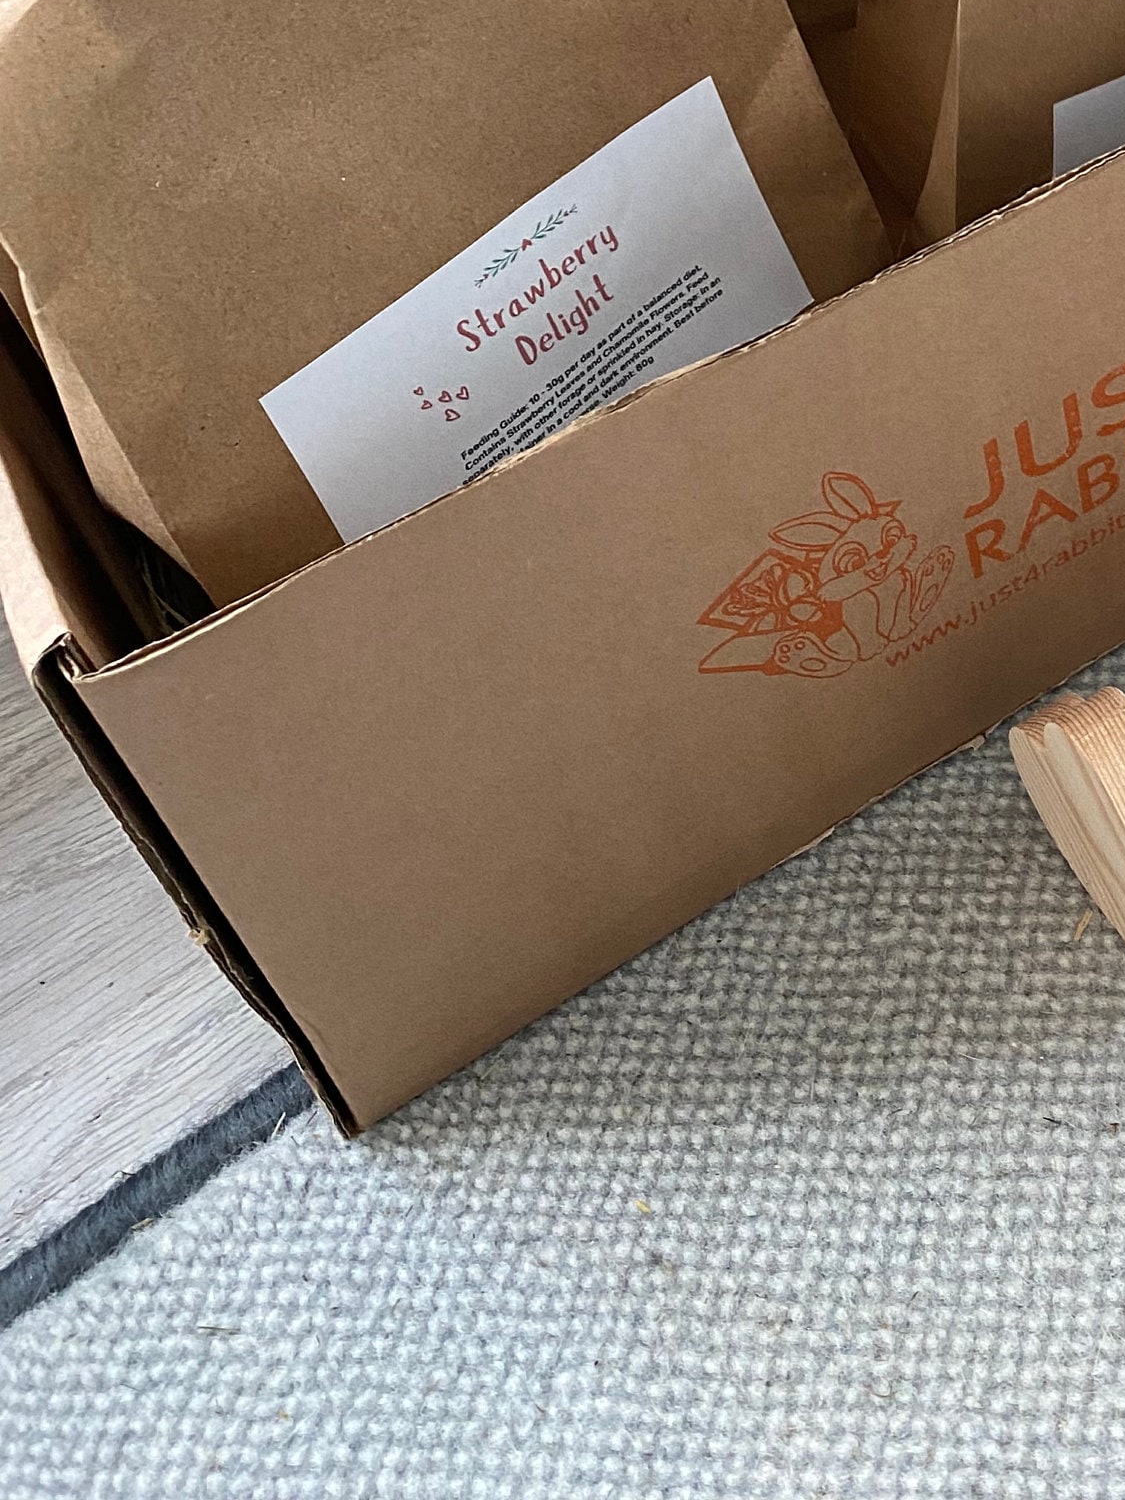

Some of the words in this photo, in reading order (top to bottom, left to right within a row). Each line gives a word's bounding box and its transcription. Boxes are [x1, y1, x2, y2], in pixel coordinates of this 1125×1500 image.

[456, 222, 619, 352] Strawberry
[512, 427, 534, 446] with
[533, 402, 557, 430] other
[556, 382, 586, 409] forage
[586, 373, 596, 385] or
[596, 339, 636, 376] sprinkled
[634, 334, 646, 344] in
[709, 276, 721, 288] an
[515, 274, 614, 365] Delight
[544, 423, 556, 434] in
[555, 417, 563, 426] a
[562, 398, 583, 419] cool
[582, 383, 600, 403] and
[598, 368, 620, 388] dark
[672, 308, 695, 329] Best
[692, 288, 723, 313] before
[459, 427, 500, 461] Feeding
[527, 392, 540, 405] 10
[545, 373, 565, 392] 30g
[563, 360, 579, 379] per
[579, 346, 596, 363] day
[595, 337, 608, 350] as
[606, 321, 626, 342] part
[625, 312, 636, 325] of
[636, 309, 643, 317] a
[641, 276, 683, 312] balanced
[464, 432, 507, 471] Contains
[505, 395, 555, 438] Strawberry
[553, 369, 586, 398] Leaves
[585, 353, 603, 373] and
[601, 317, 650, 358] Chamomile
[685, 270, 709, 293] Feed
